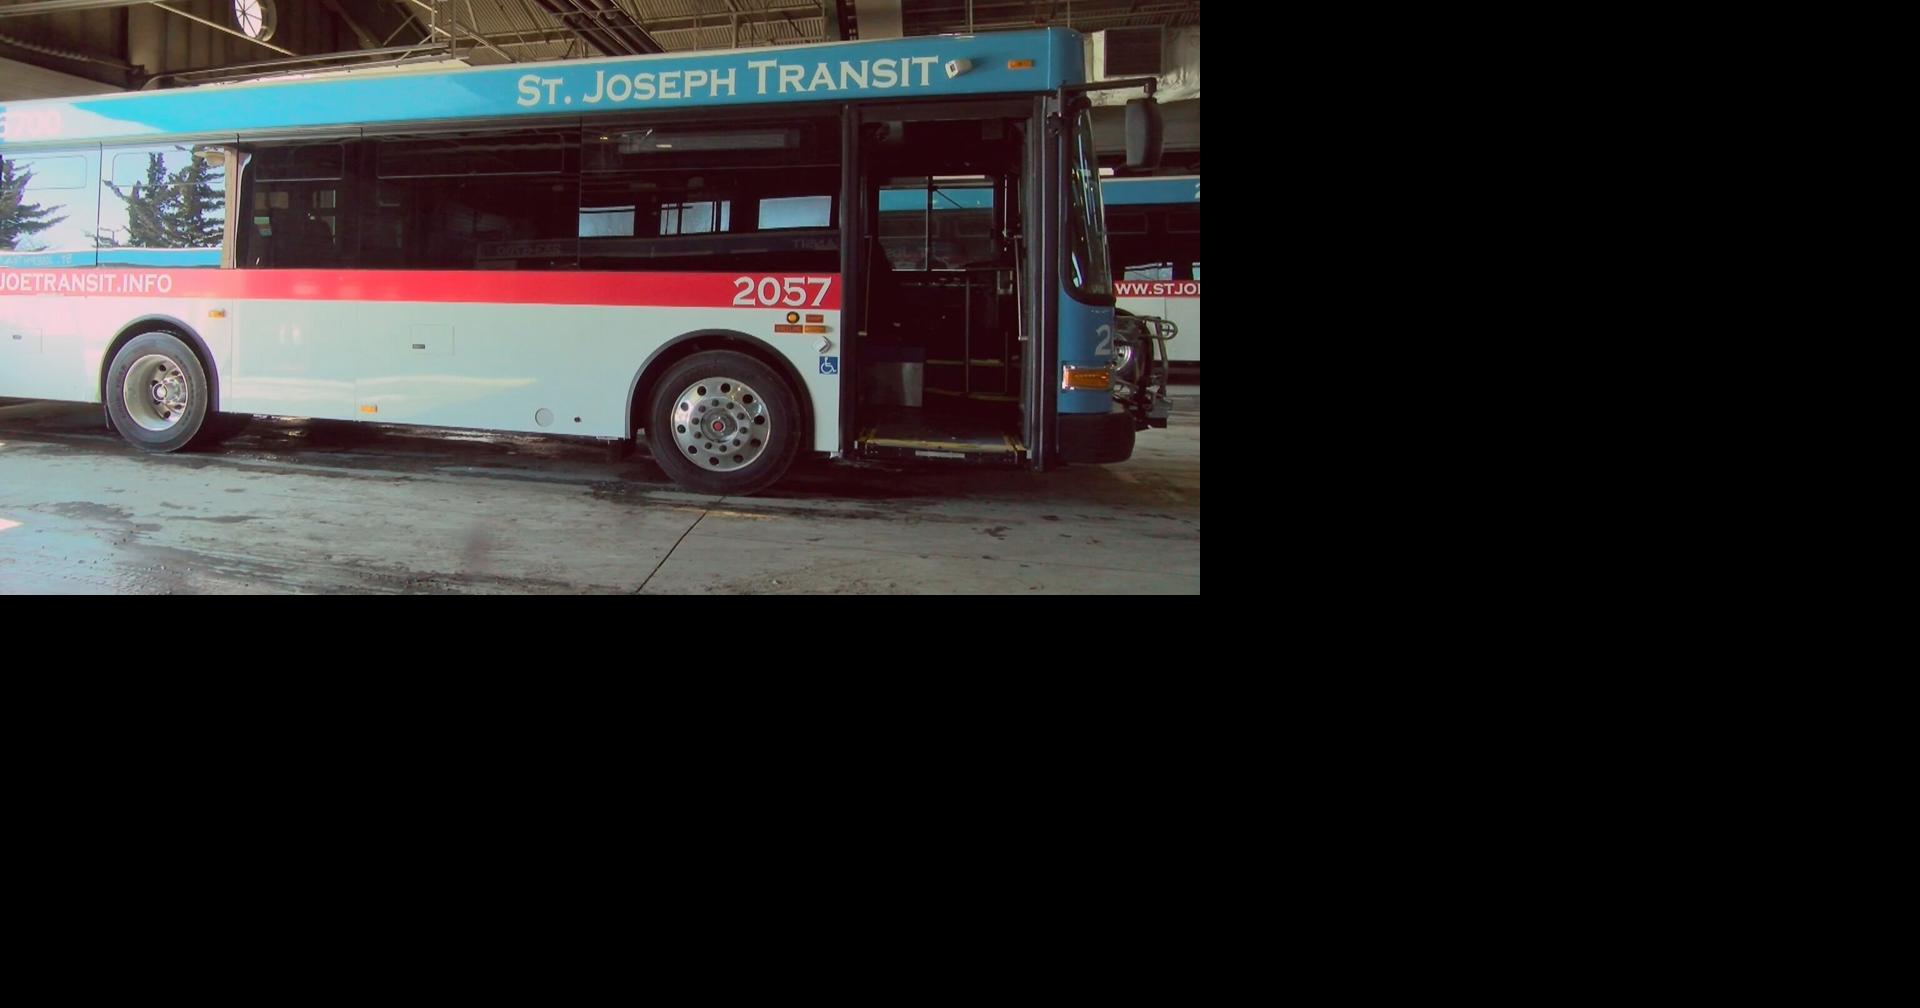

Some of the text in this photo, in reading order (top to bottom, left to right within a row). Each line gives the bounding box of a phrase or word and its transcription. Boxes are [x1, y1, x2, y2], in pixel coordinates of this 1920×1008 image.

[517, 55, 939, 107] ST. JOSEPH TRANSIT
[732, 275, 832, 307] 2057
[1114, 282, 1200, 295] WW.STJO
[1094, 324, 1112, 356] 2
